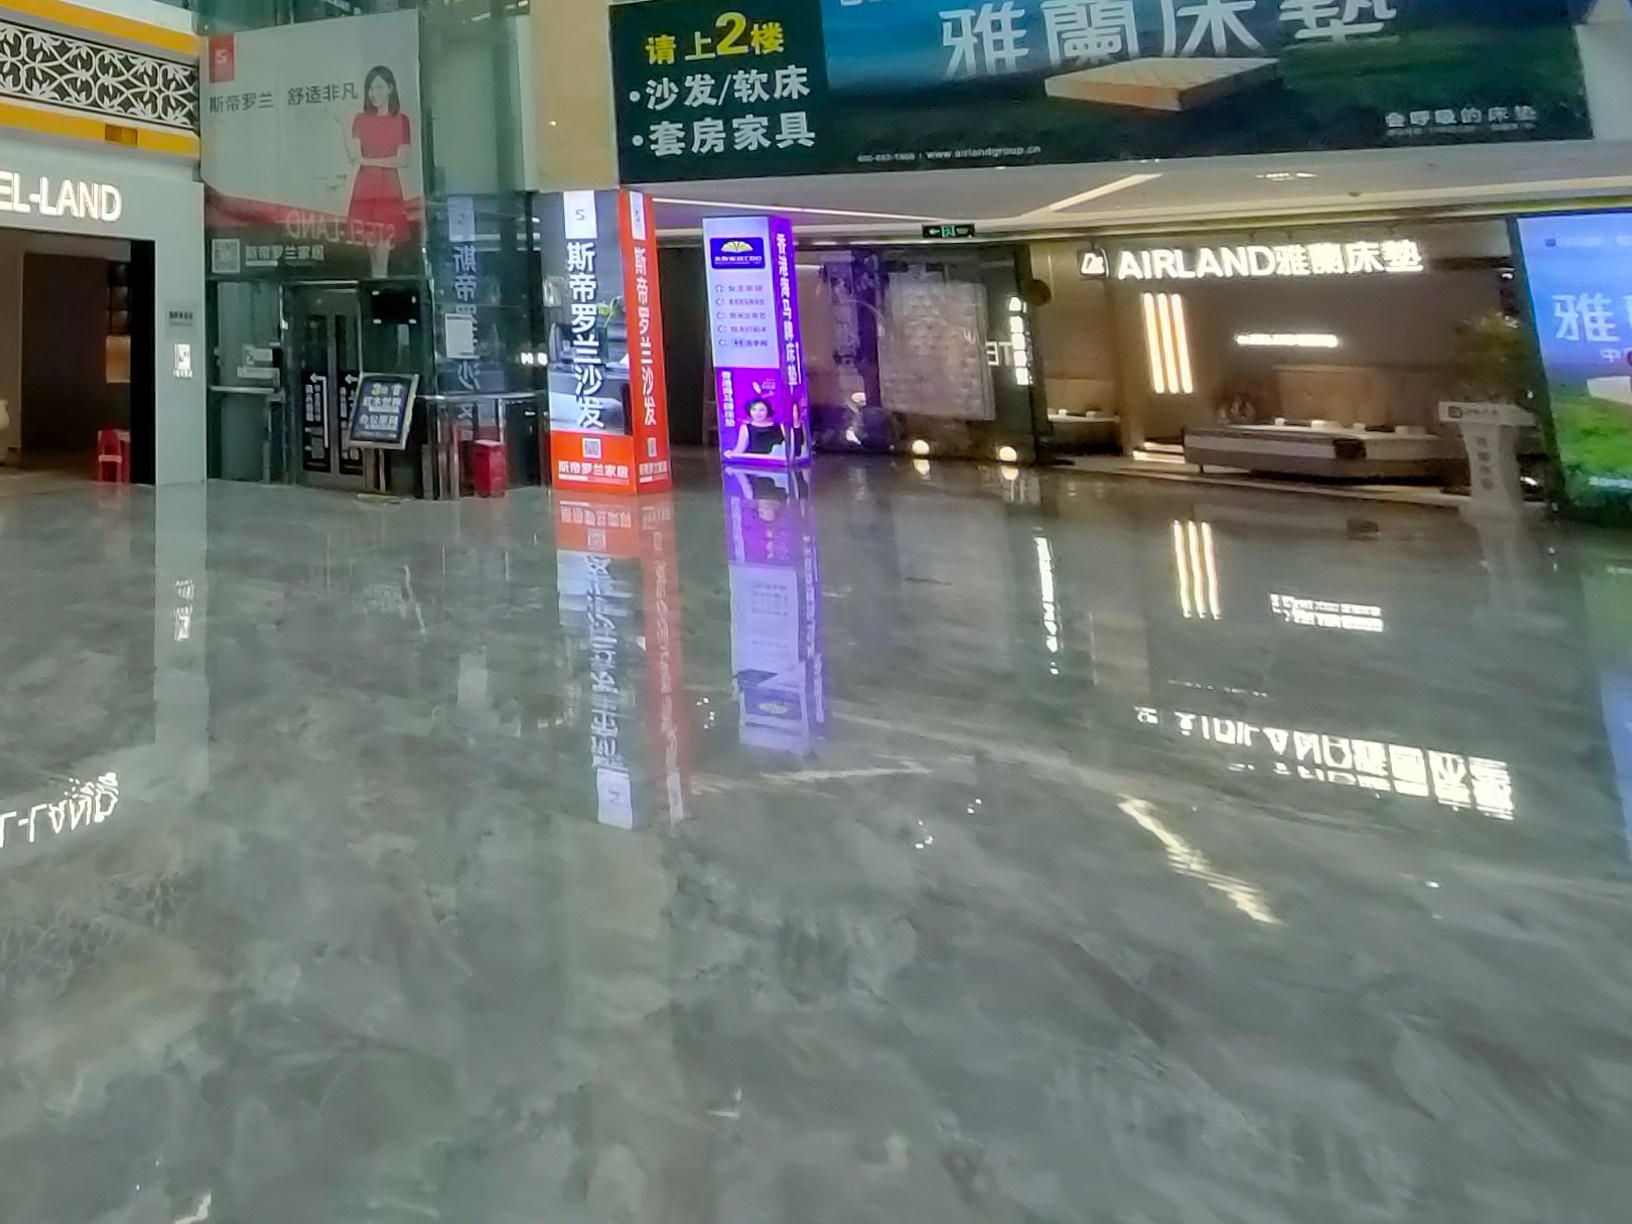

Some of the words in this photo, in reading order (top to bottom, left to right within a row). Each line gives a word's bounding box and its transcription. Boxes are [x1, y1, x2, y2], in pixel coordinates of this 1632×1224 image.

[645, 12, 785, 65] 请上2楼
[208, 90, 275, 114] 斯帝罗兰
[286, 81, 359, 107] 舒适非凡
[645, 64, 811, 111] 沙发/软床
[648, 111, 816, 157] 套房家具
[565, 241, 605, 429] 斯帝罗兰沙发
[633, 245, 657, 427] 斯帝罗兰沙发
